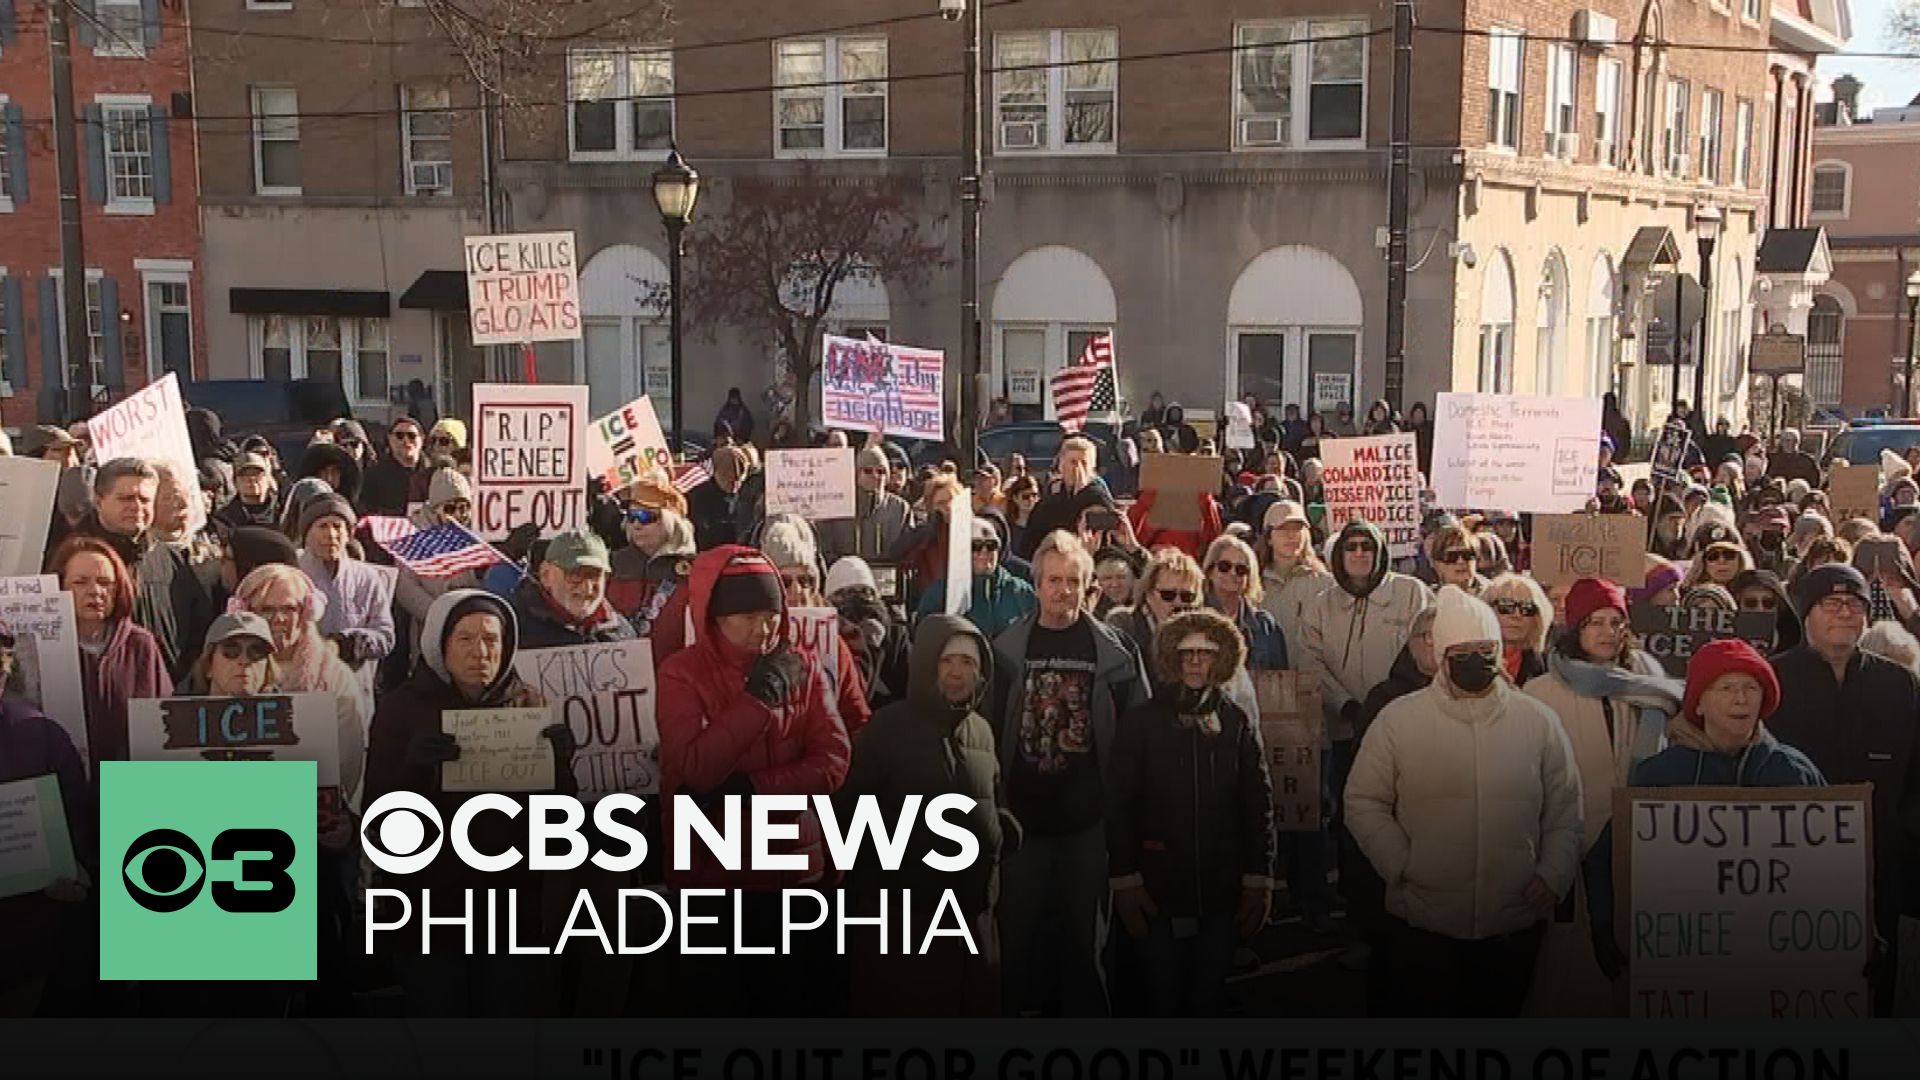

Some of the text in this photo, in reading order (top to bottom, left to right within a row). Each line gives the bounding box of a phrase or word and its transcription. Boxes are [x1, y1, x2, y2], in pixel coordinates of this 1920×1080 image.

[467, 240, 571, 275] ICE KILLS
[477, 273, 570, 302] TRUMP
[91, 382, 168, 449] WORST
[600, 407, 638, 442] ICE
[485, 448, 565, 477] RENEE
[1354, 444, 1412, 462] MALICE
[1323, 464, 1412, 483] COWARDICE
[478, 488, 584, 532] ICE OUT
[1326, 485, 1413, 502] DISSERVICE
[1558, 544, 1622, 576] ICE
[1665, 603, 1738, 633] THE
[1637, 633, 1693, 657] ICE
[536, 649, 628, 698] KINGS
[198, 701, 281, 745] ICE
[564, 688, 648, 749] OUT
[1637, 802, 1856, 849] JUSTICE
[1717, 858, 1791, 895] FOR
[1635, 910, 1863, 958] RENEE GOOD
